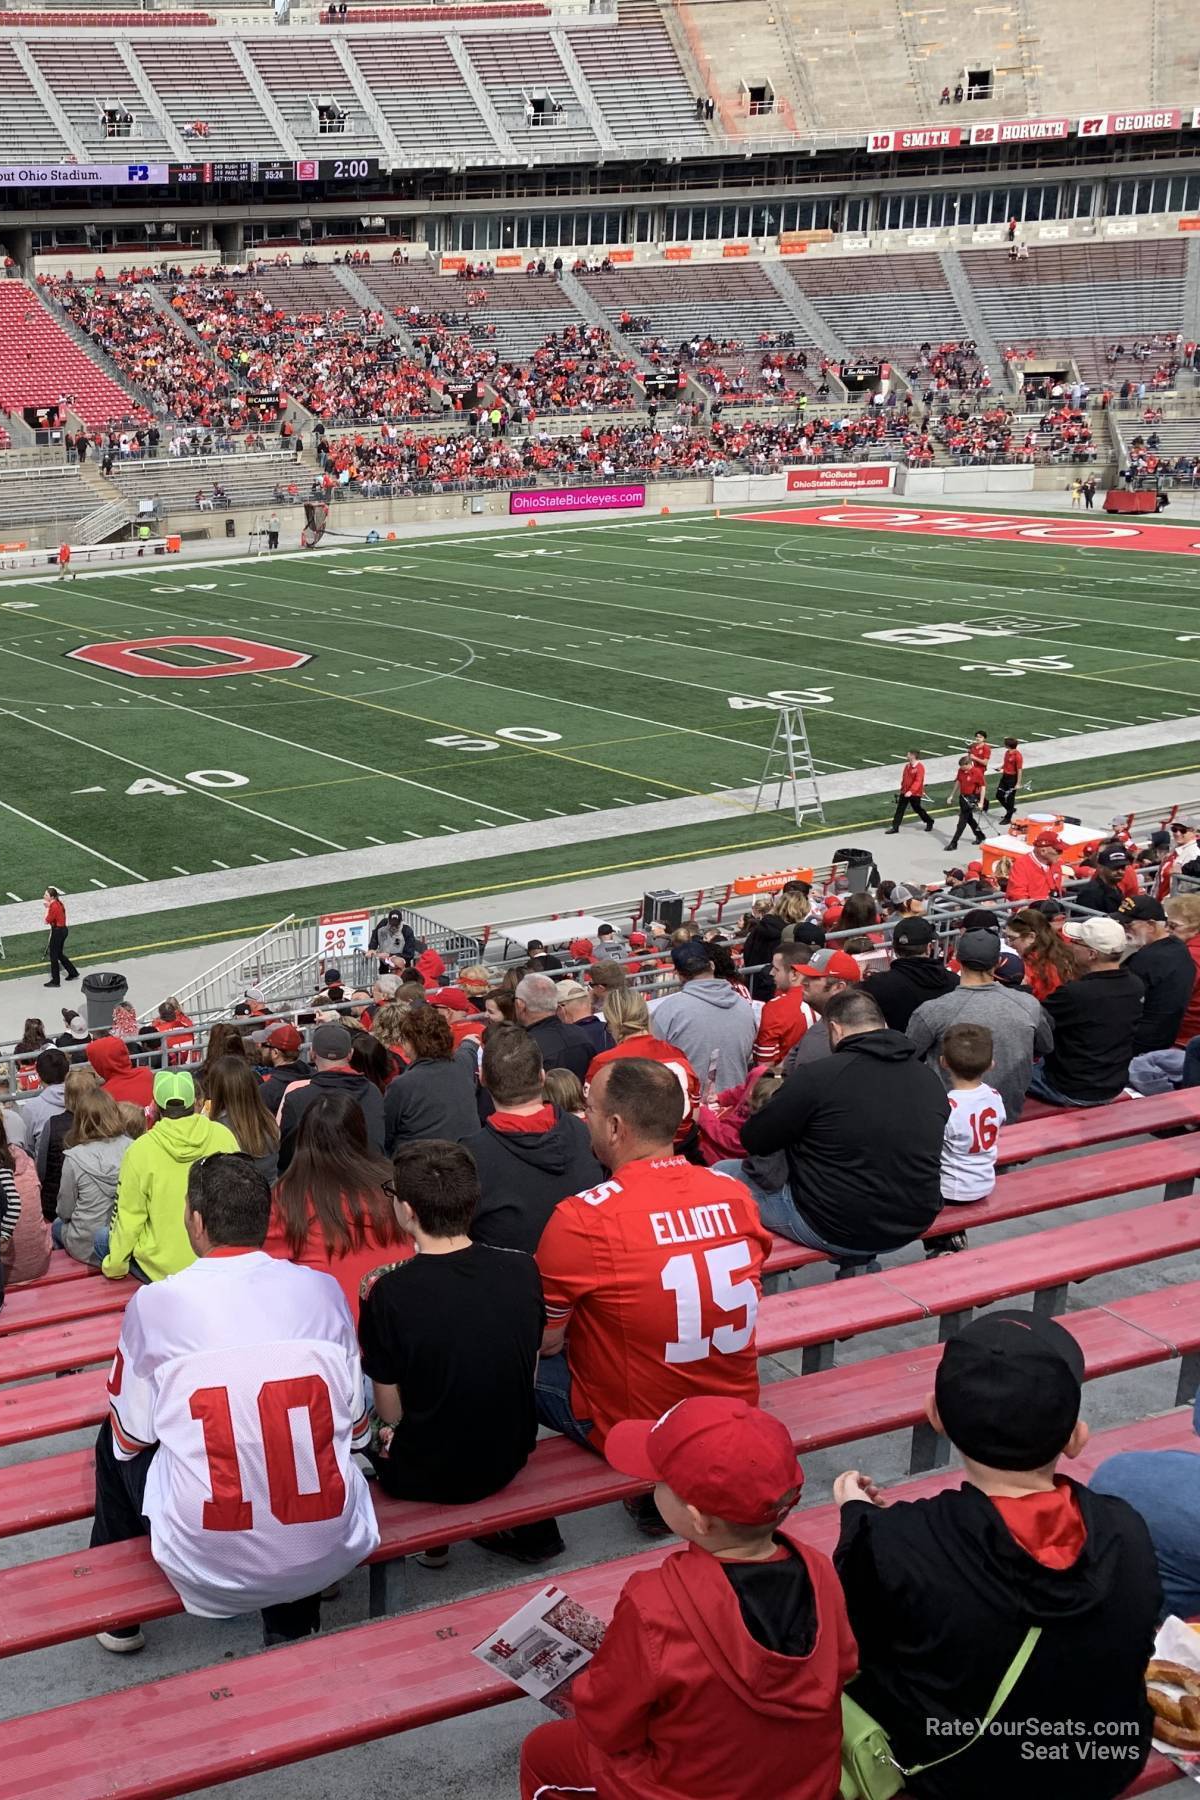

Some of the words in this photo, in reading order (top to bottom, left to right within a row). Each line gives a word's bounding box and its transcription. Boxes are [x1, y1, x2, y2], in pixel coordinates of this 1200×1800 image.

[974, 128, 994, 142] 22
[1001, 120, 1065, 140] HORVATH
[1082, 119, 1103, 135] 27
[1114, 113, 1173, 131] GEORGE
[872, 136, 890, 150] 10
[901, 130, 950, 148] SMITH
[18, 170, 47, 181] Ohio
[51, 169, 102, 181] Stadium.
[334, 160, 369, 178] 2:00
[514, 492, 643, 508] OhioStateBuckeyes.com
[817, 512, 1143, 539] OHIO
[426, 727, 563, 752] 50
[124, 769, 250, 796] 40
[968, 1106, 998, 1154] 16
[649, 1202, 738, 1246] ELLIOTT
[660, 1240, 760, 1364] 15
[188, 1374, 346, 1532] 10
